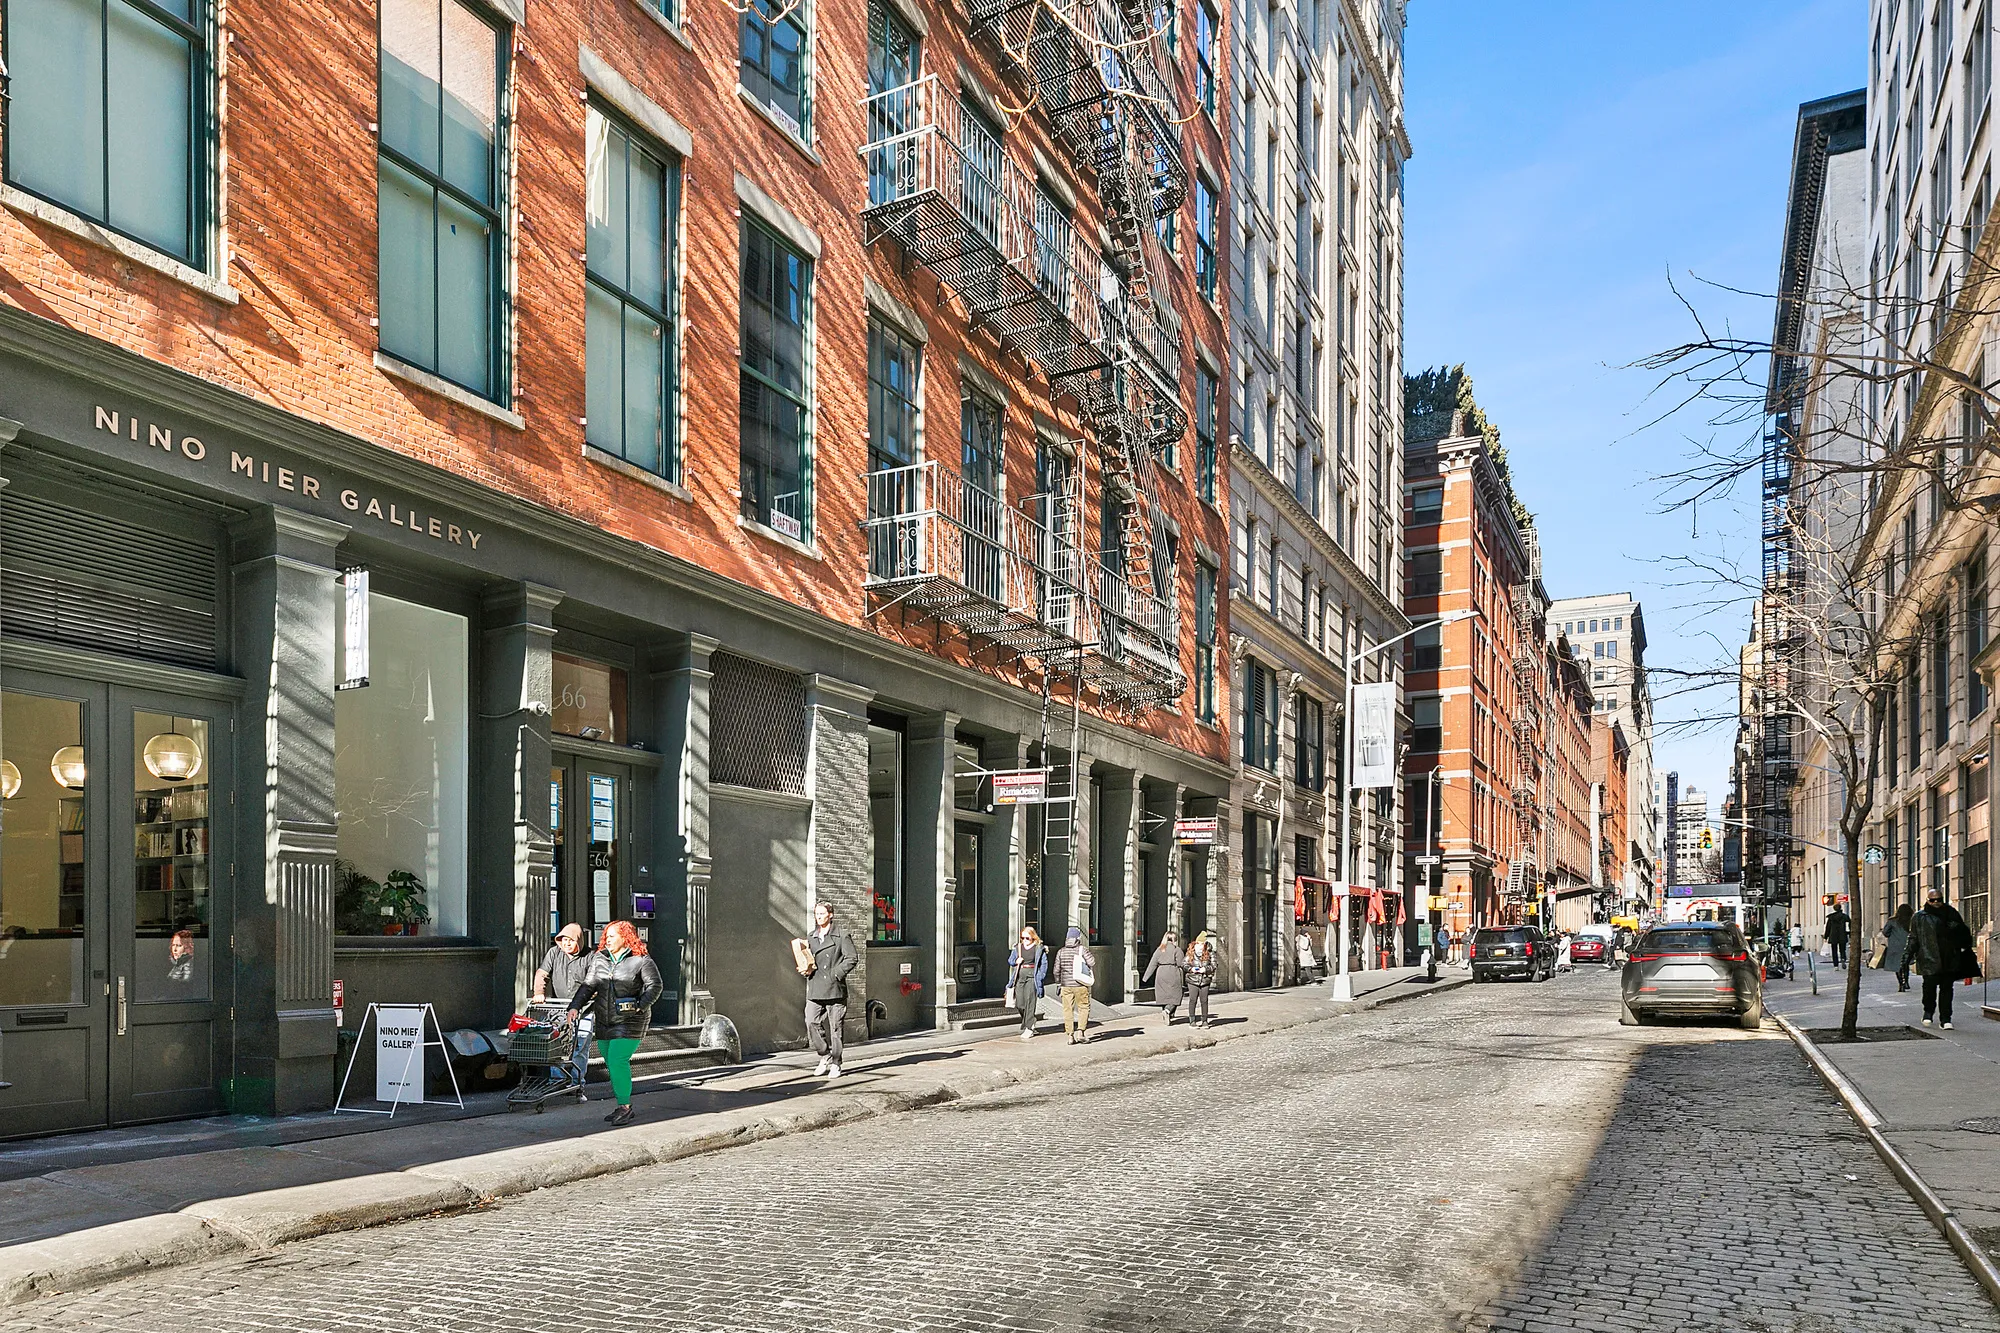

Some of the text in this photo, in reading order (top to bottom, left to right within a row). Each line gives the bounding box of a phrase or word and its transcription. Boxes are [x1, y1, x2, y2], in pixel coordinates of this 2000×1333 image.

[95, 405, 482, 551] NINO MIER GALLERY
[562, 683, 586, 710] 66
[380, 1027, 399, 1036] NINO
